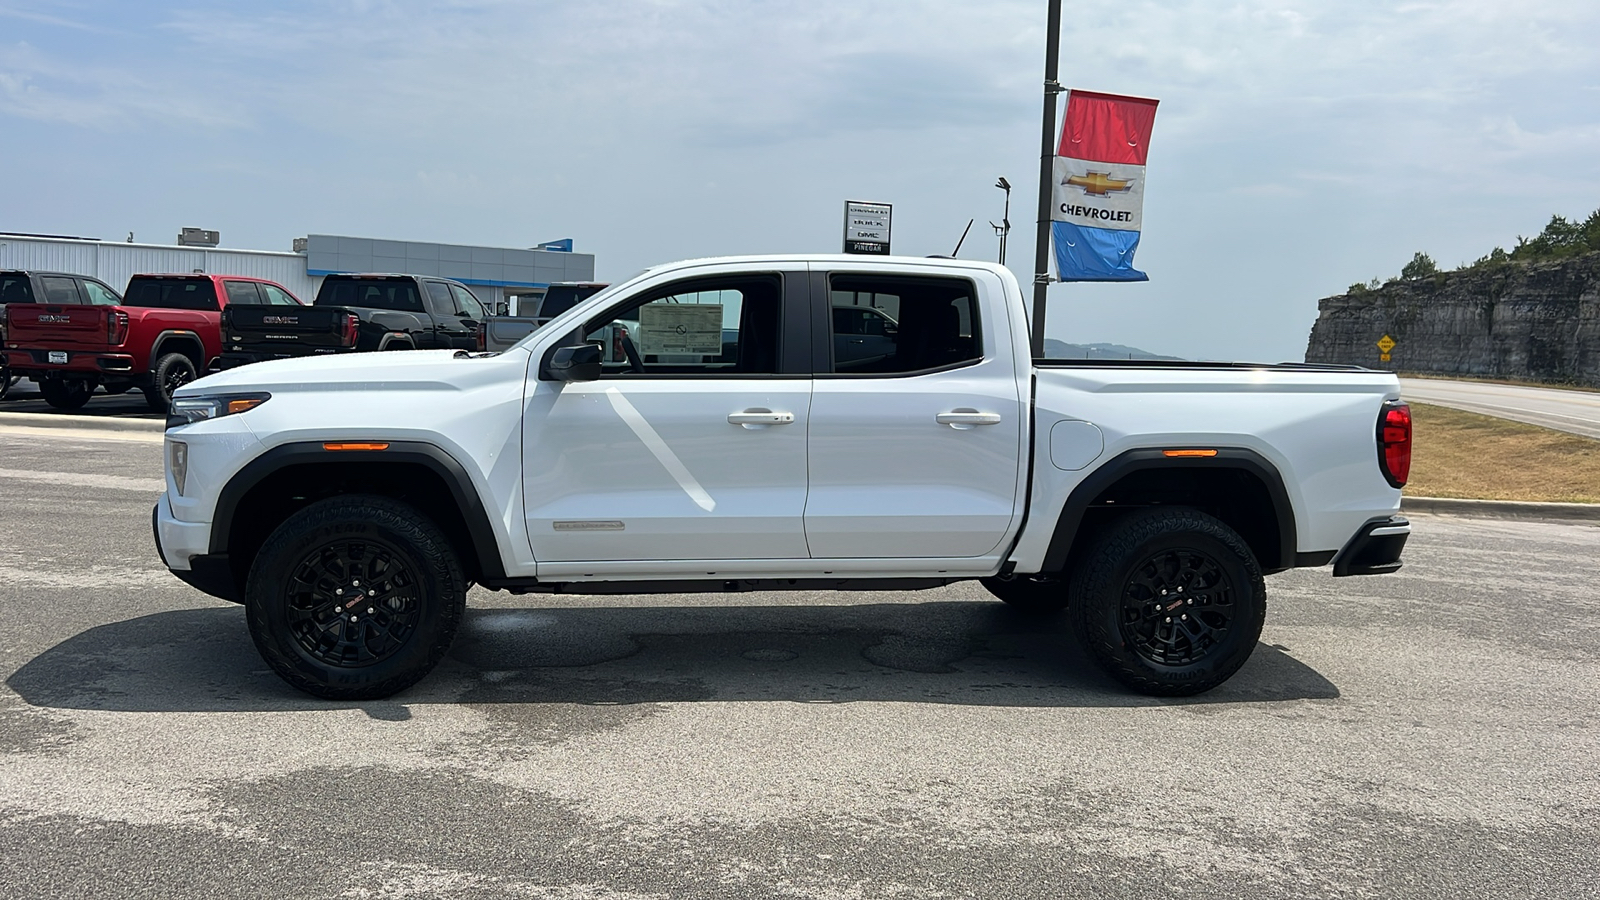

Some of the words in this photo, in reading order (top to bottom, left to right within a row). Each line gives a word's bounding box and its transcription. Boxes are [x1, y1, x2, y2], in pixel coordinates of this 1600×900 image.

[1060, 203, 1132, 222] CHEVROLET
[857, 231, 879, 239] GMC
[854, 244, 881, 252] PINEGAR
[38, 315, 70, 323] GMC
[263, 316, 298, 324] GMC
